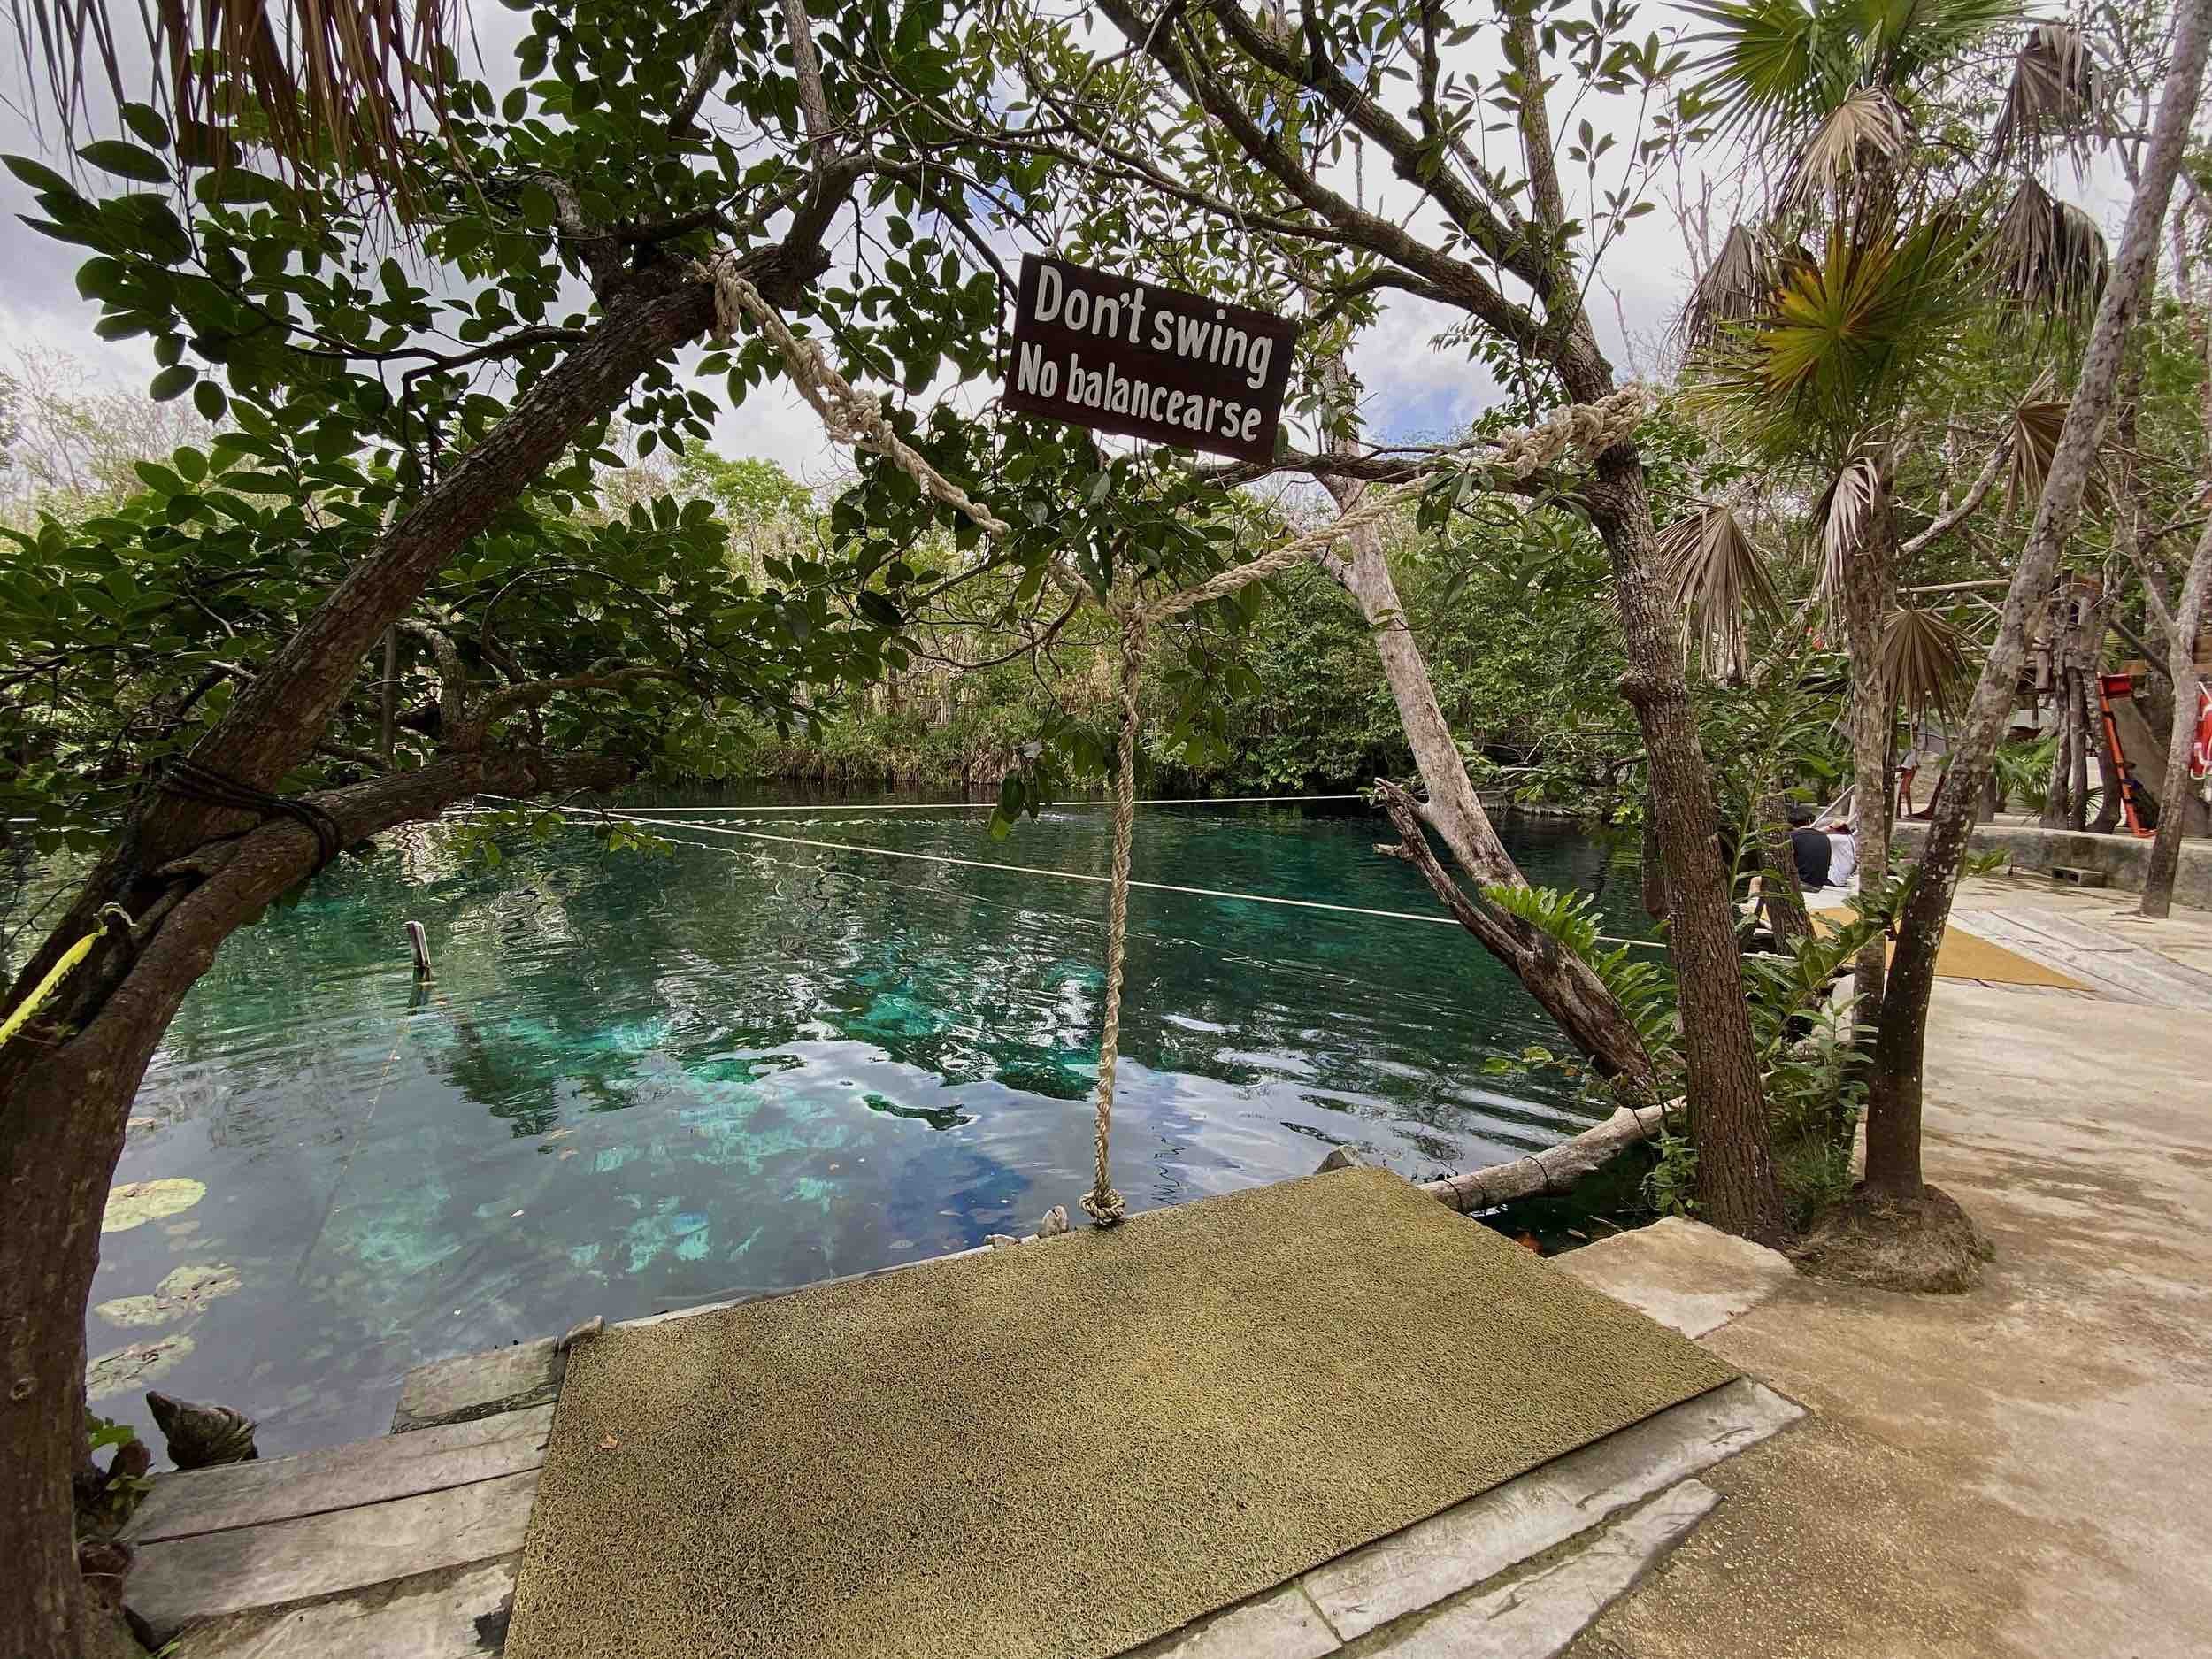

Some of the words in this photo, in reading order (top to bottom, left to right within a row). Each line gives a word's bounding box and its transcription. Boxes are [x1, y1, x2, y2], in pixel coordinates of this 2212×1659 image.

[1034, 265, 1146, 344] Don't
[1150, 308, 1273, 389] swing
[1018, 342, 1058, 398] No
[1066, 353, 1262, 442] balancearse
